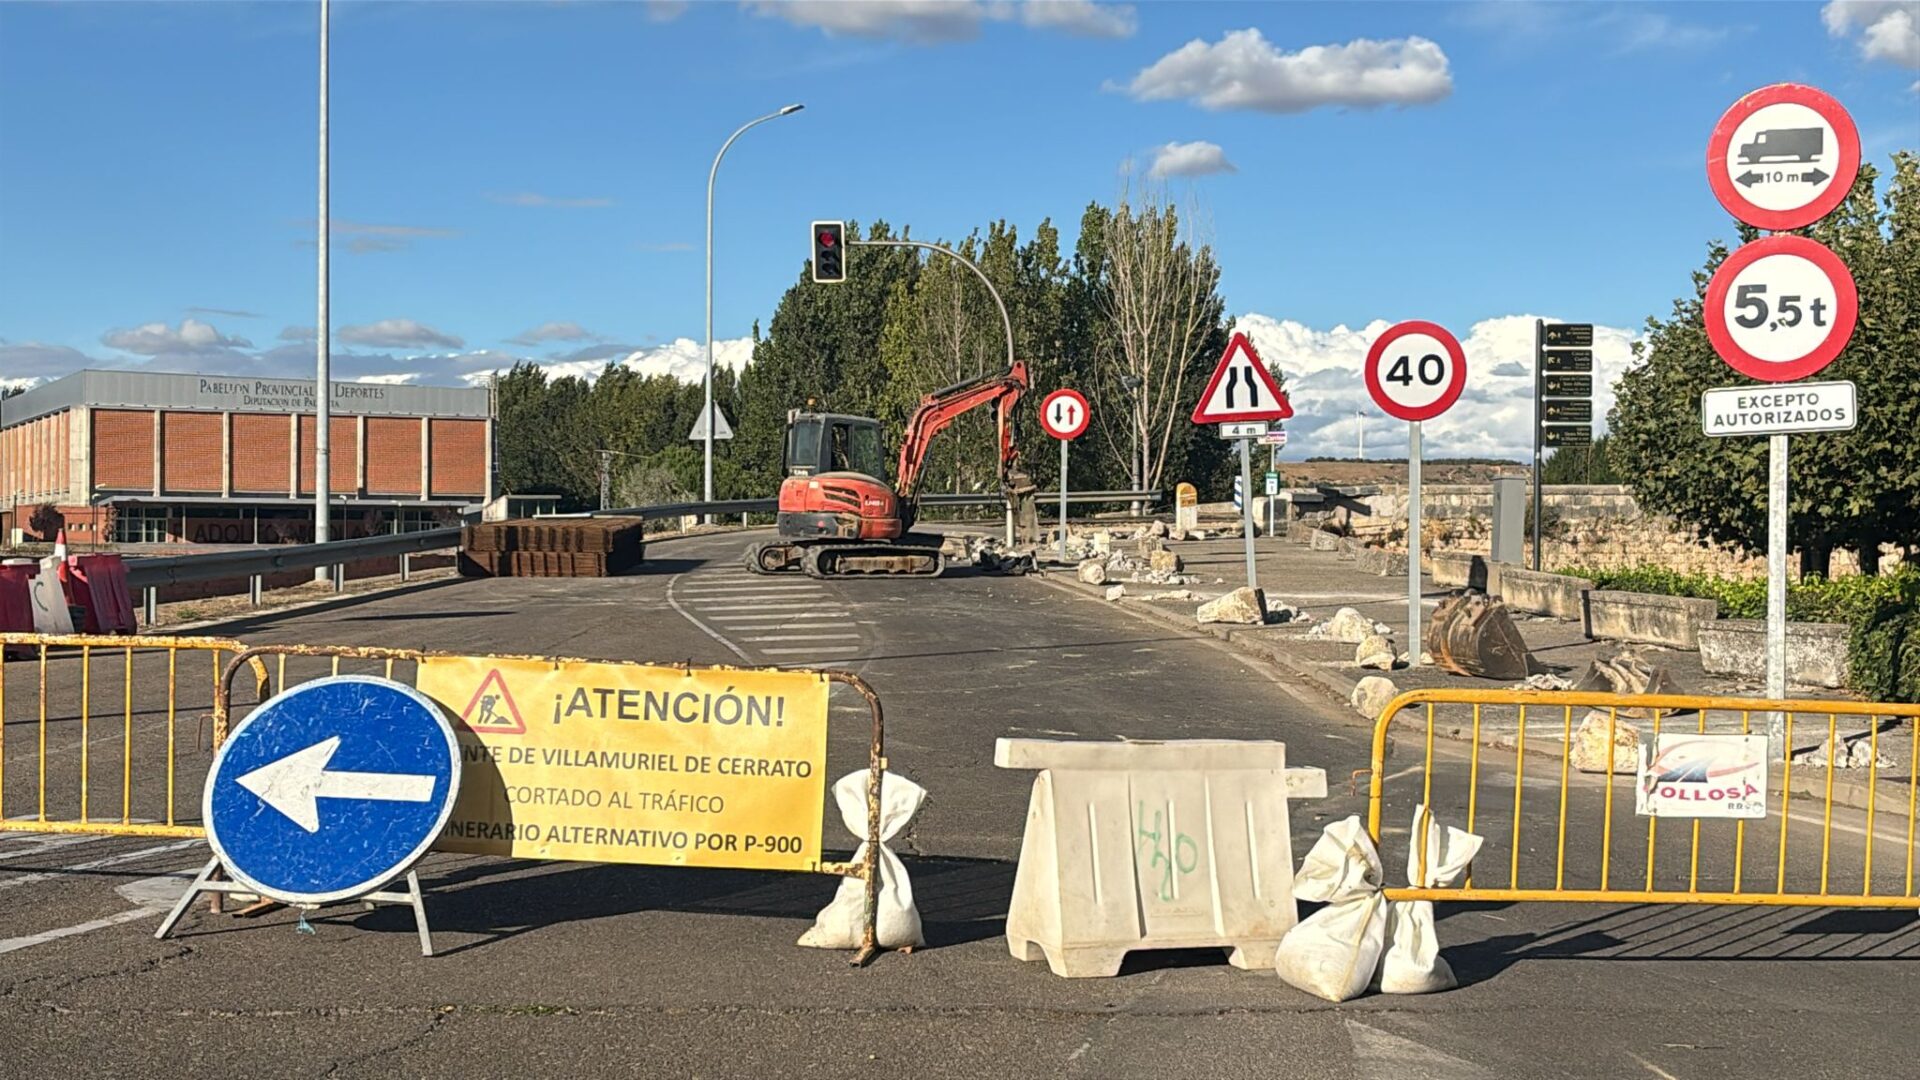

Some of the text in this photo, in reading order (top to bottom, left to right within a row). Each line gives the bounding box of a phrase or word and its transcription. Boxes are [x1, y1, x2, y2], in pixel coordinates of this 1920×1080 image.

[1765, 171, 1799, 183] 10 m
[1734, 284, 1827, 332] 5,5 t
[1386, 353, 1445, 387] 40
[334, 383, 385, 400] DEPORTES
[1737, 393, 1819, 409] EXCEPTO
[1713, 407, 1846, 427] AUTORIZADOS
[1232, 426, 1240, 434] 4
[553, 685, 784, 727] ¡ATENCIÓN!
[460, 743, 812, 778] NTE DE VILLAMURIEL DE CERRATO
[504, 786, 724, 814] CORTADO AL TRÁFICO
[1643, 783, 1758, 801] OLLOSA
[546, 825, 688, 849] ALTERNATIVO
[694, 832, 737, 852] POR
[744, 834, 803, 854] P-900
